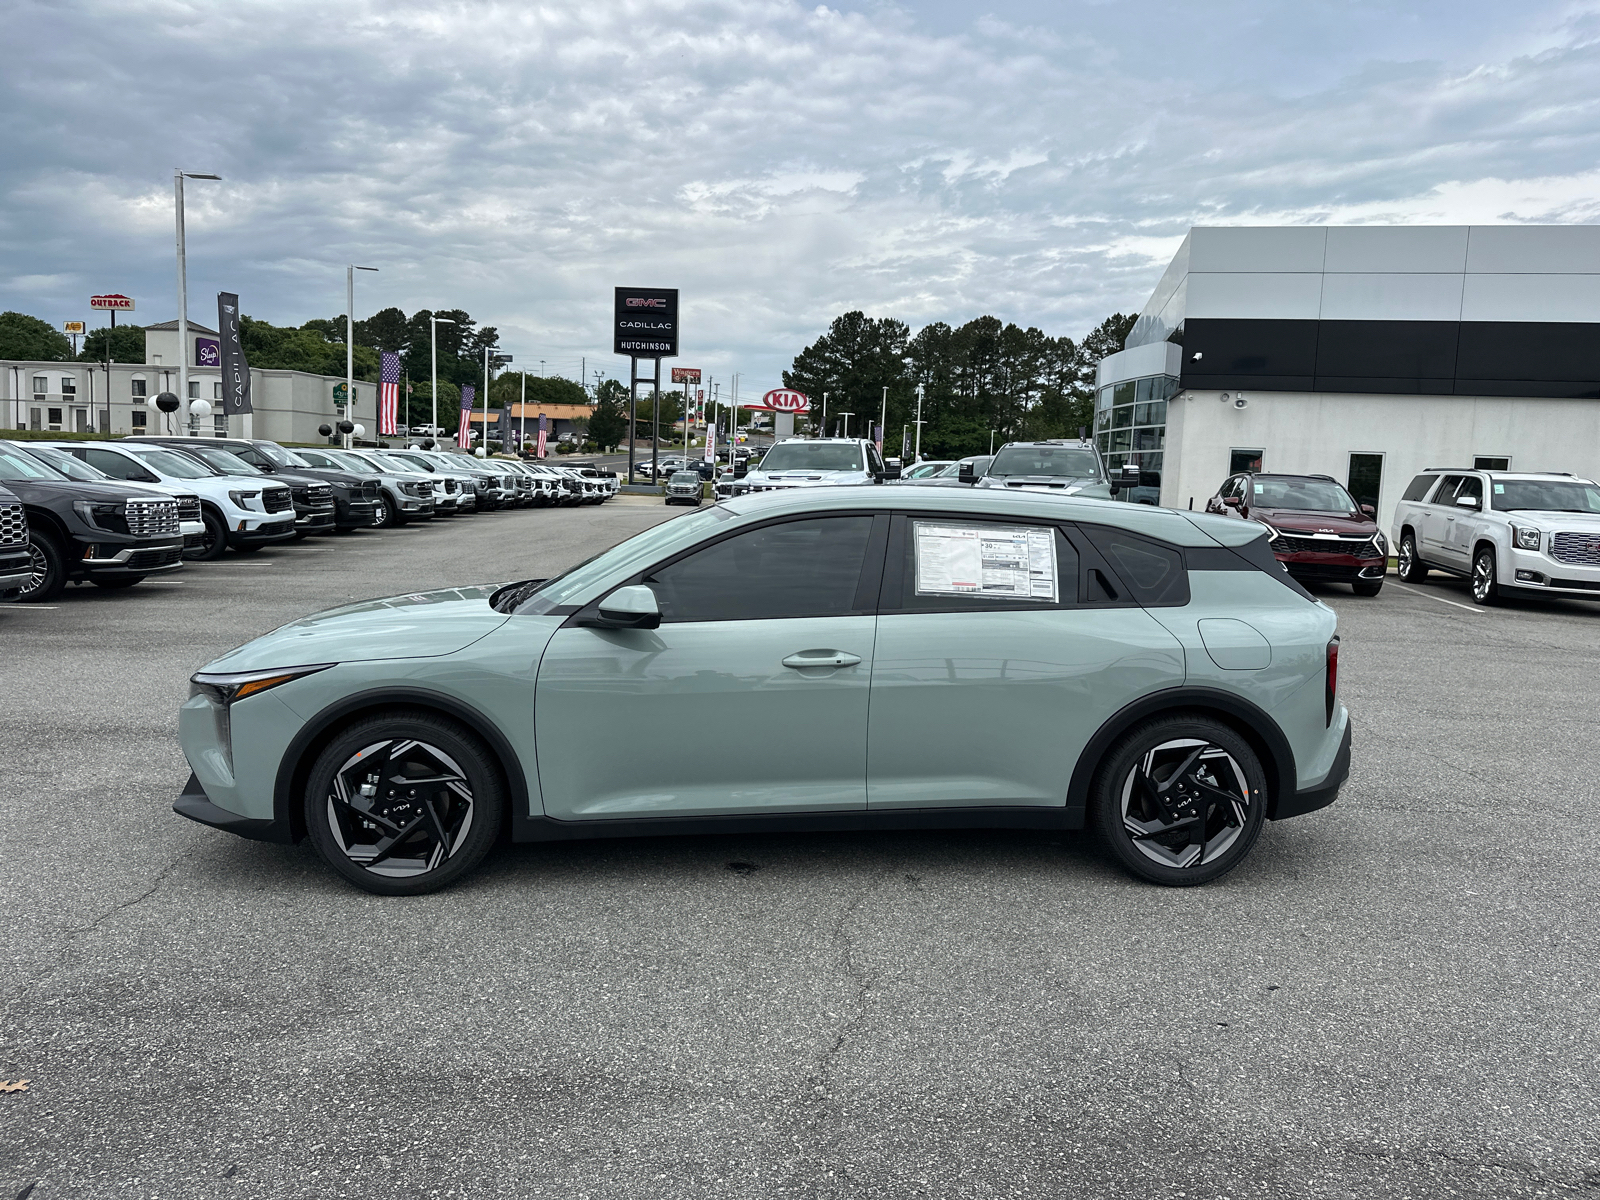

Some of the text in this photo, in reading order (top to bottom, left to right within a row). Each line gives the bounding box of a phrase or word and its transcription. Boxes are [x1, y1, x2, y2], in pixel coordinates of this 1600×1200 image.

[90, 299, 131, 307] OUTBACK
[626, 297, 666, 308] GMC
[619, 321, 672, 329] CADILLAC
[621, 341, 671, 350] HUTCHINSON
[772, 393, 800, 408] KIA
[706, 430, 714, 457] GMC
